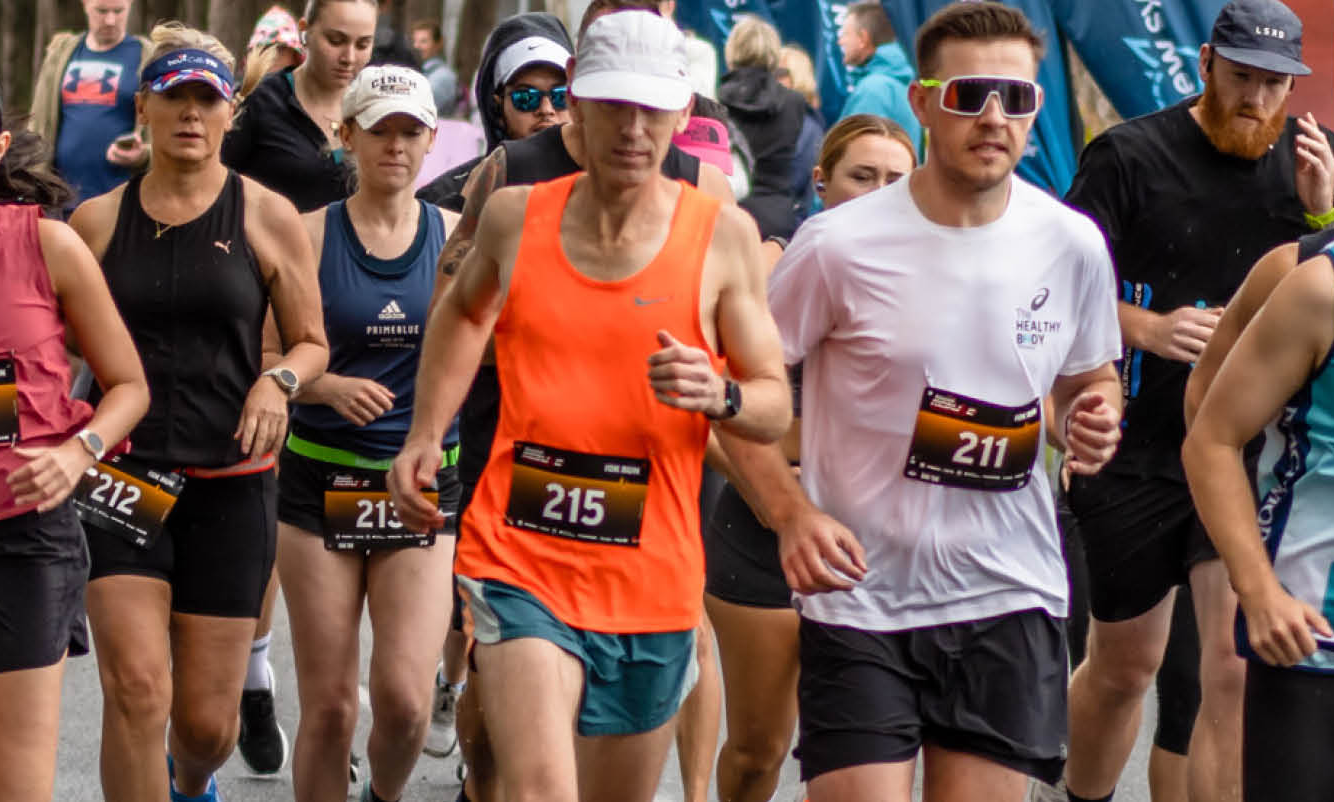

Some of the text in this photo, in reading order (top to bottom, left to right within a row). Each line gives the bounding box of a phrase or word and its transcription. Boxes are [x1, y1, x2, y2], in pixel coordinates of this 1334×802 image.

[366, 325, 420, 336] PRIMEBLUE
[951, 431, 1008, 468] 211
[90, 473, 141, 515] 212
[542, 482, 605, 527] 215
